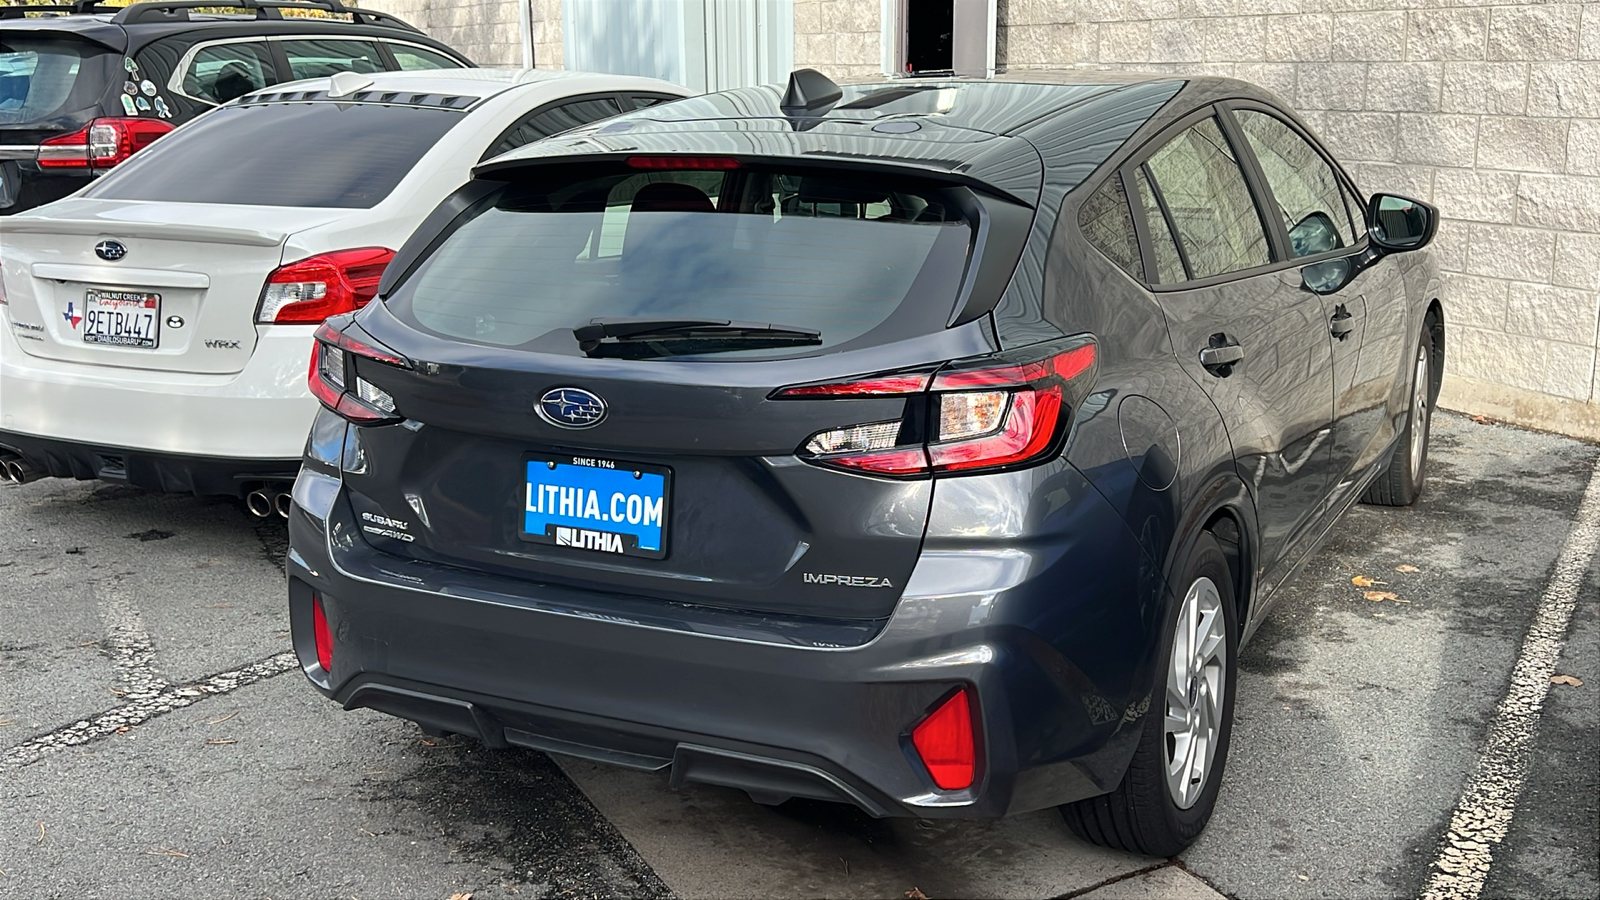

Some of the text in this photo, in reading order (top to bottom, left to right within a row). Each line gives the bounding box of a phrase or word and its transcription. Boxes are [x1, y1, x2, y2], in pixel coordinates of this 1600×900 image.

[100, 292, 122, 300] WALNUT
[123, 293, 141, 301] CREEK
[87, 310, 153, 339] 9ETB447
[204, 339, 242, 350] WRX
[572, 456, 616, 469] SINCE 1946
[525, 482, 664, 528] LITHIA.COM
[361, 512, 408, 530] SUBARU
[571, 528, 624, 553] LITHIA
[803, 572, 893, 588] IMPREZA
